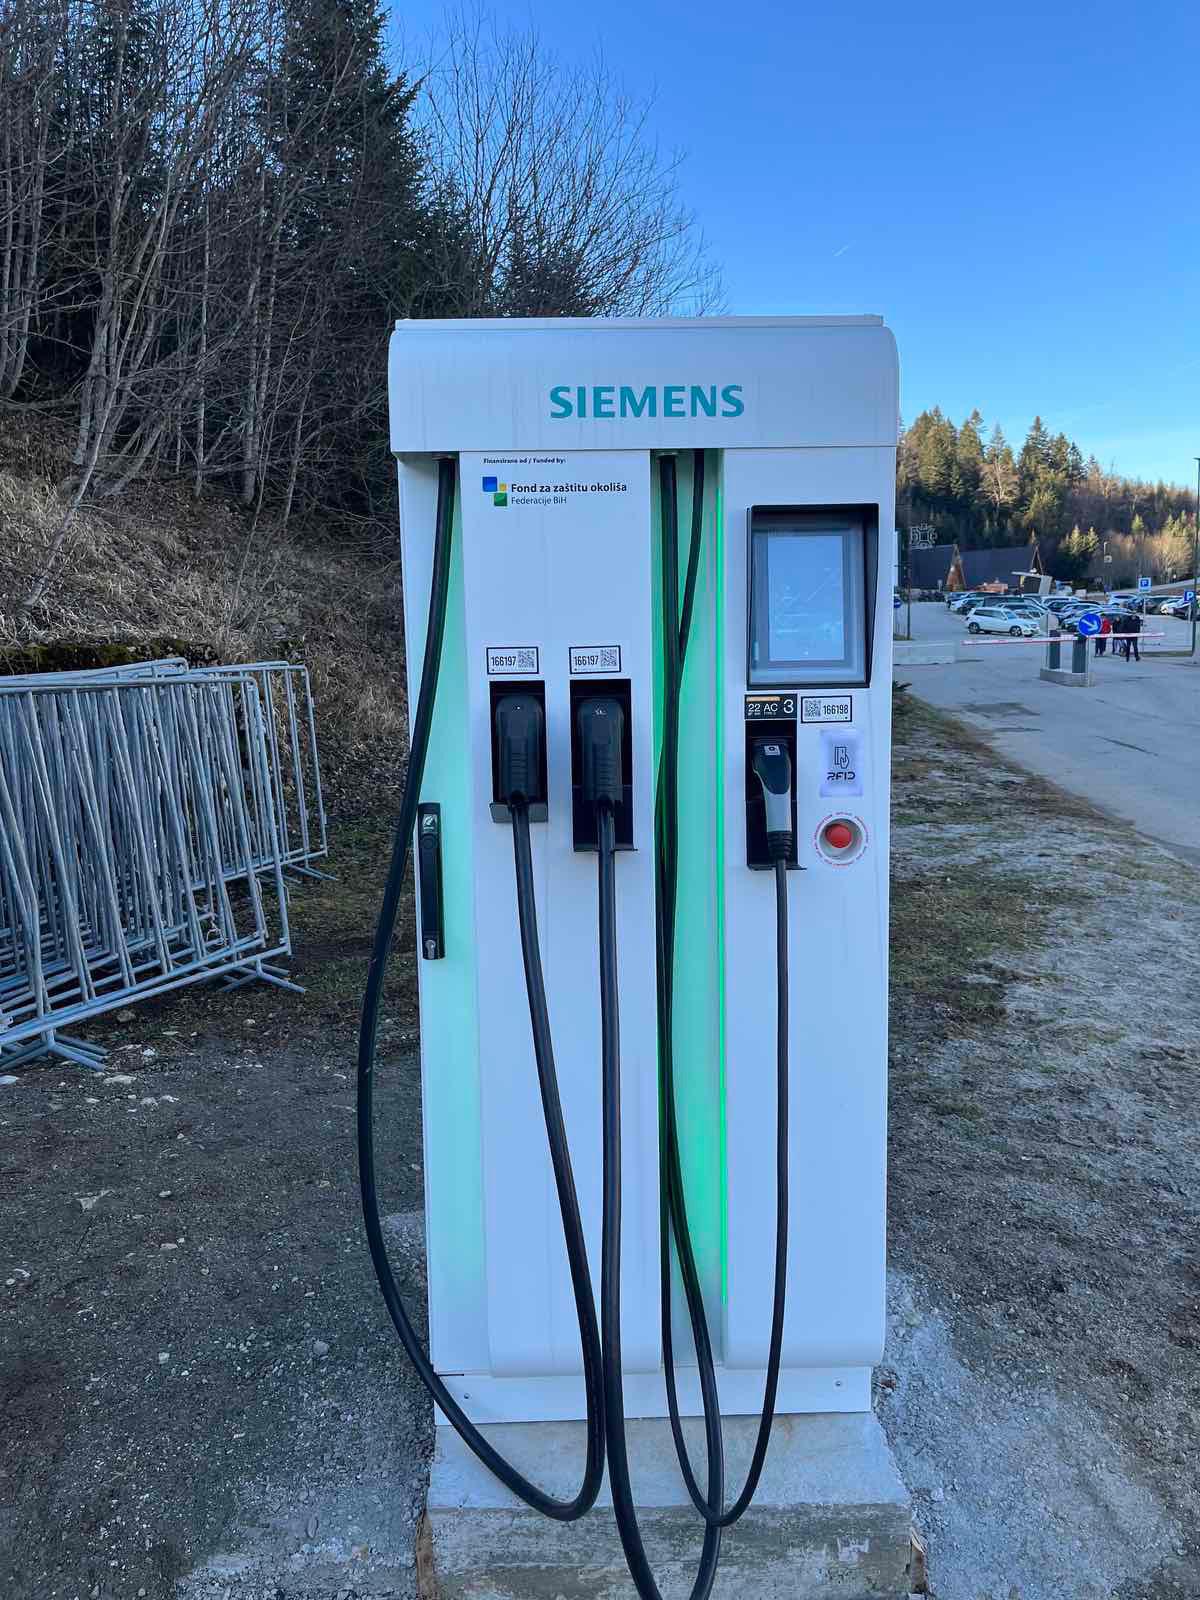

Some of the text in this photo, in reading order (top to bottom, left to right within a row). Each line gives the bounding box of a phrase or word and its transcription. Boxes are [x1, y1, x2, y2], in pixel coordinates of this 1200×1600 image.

[550, 385, 745, 418] SIEMENS
[511, 482, 627, 493] Fond za zaštitu okoliša
[511, 496, 552, 506] Federacije
[1186, 591, 1194, 601] P
[491, 656, 517, 667] 166197
[574, 655, 599, 666] 166197
[748, 703, 778, 713] 22 AC
[783, 700, 794, 713] 3
[823, 704, 849, 715] 166198
[826, 771, 856, 781] RFID
